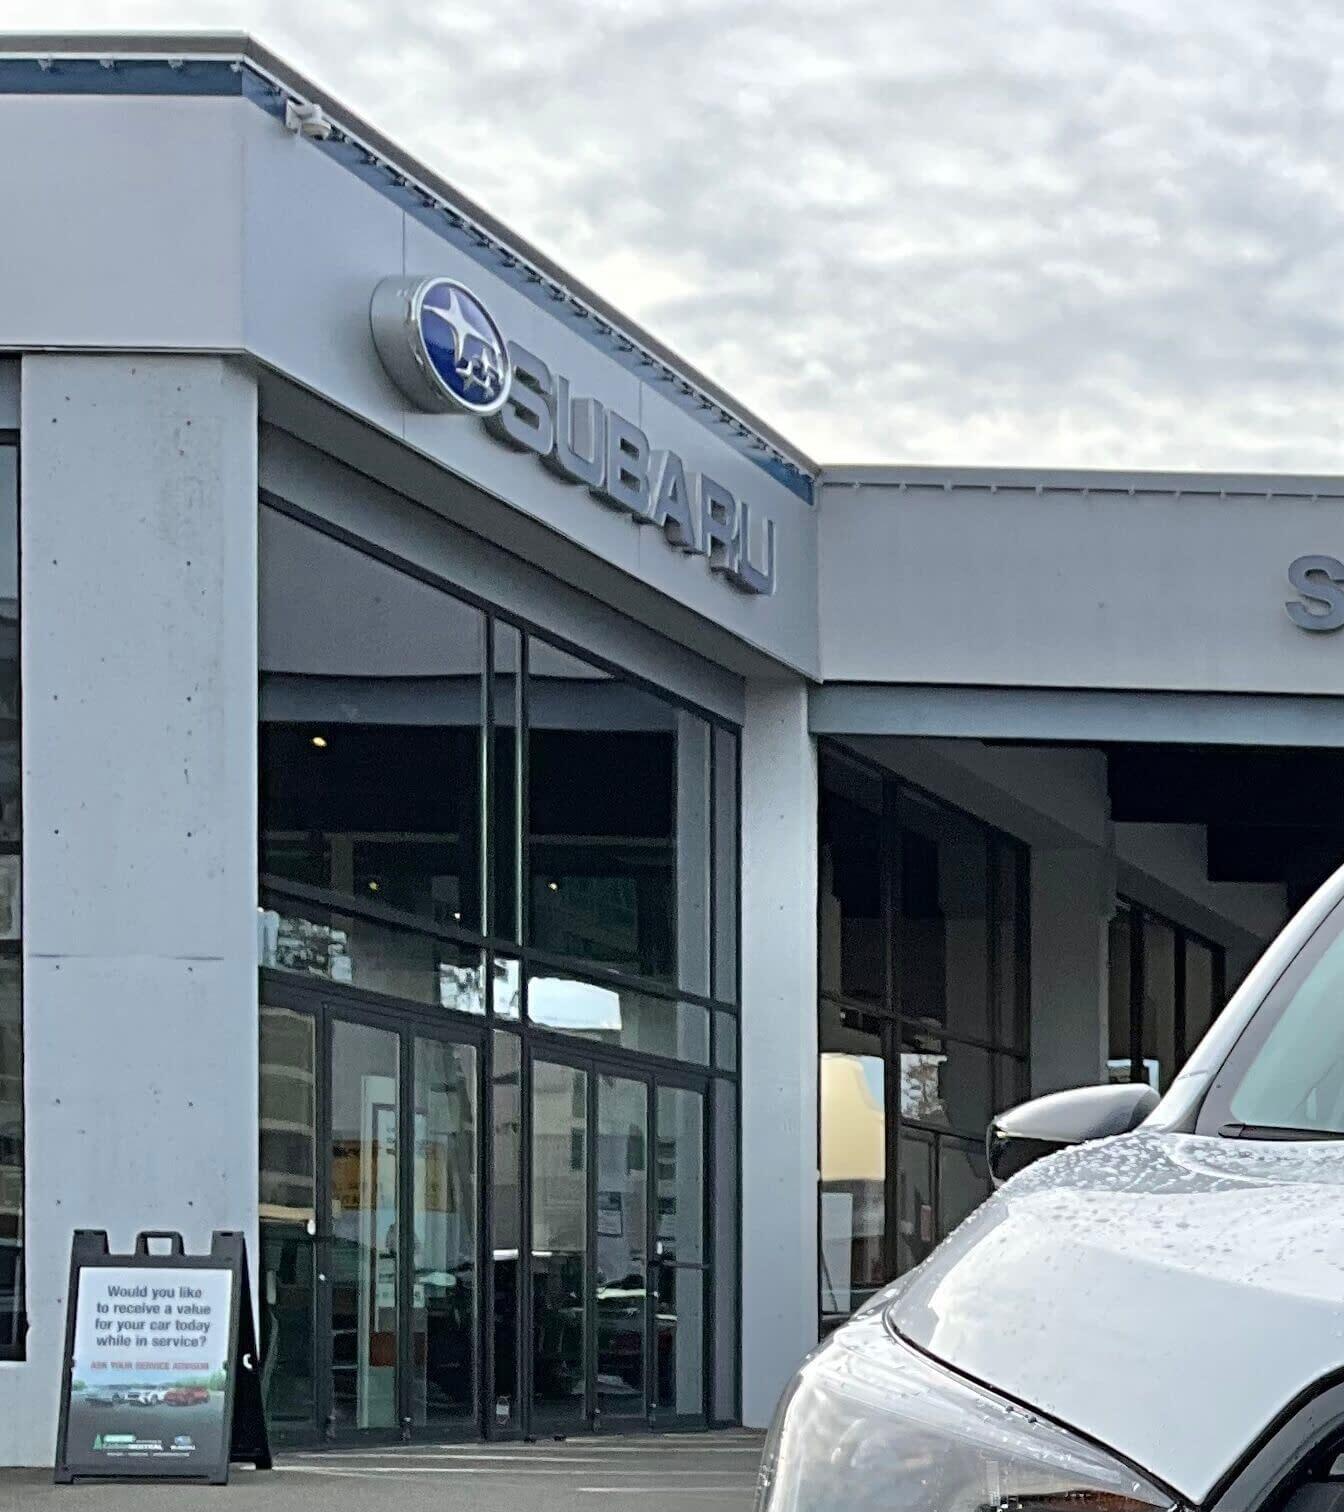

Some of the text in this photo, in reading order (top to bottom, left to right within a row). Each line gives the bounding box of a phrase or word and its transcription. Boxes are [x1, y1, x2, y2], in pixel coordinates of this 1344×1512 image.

[490, 340, 776, 597] SUBARU
[107, 1285, 202, 1300] Would you like
[96, 1302, 211, 1315] to receive a value
[95, 1318, 211, 1333] for your car today
[96, 1334, 207, 1347] while in service?
